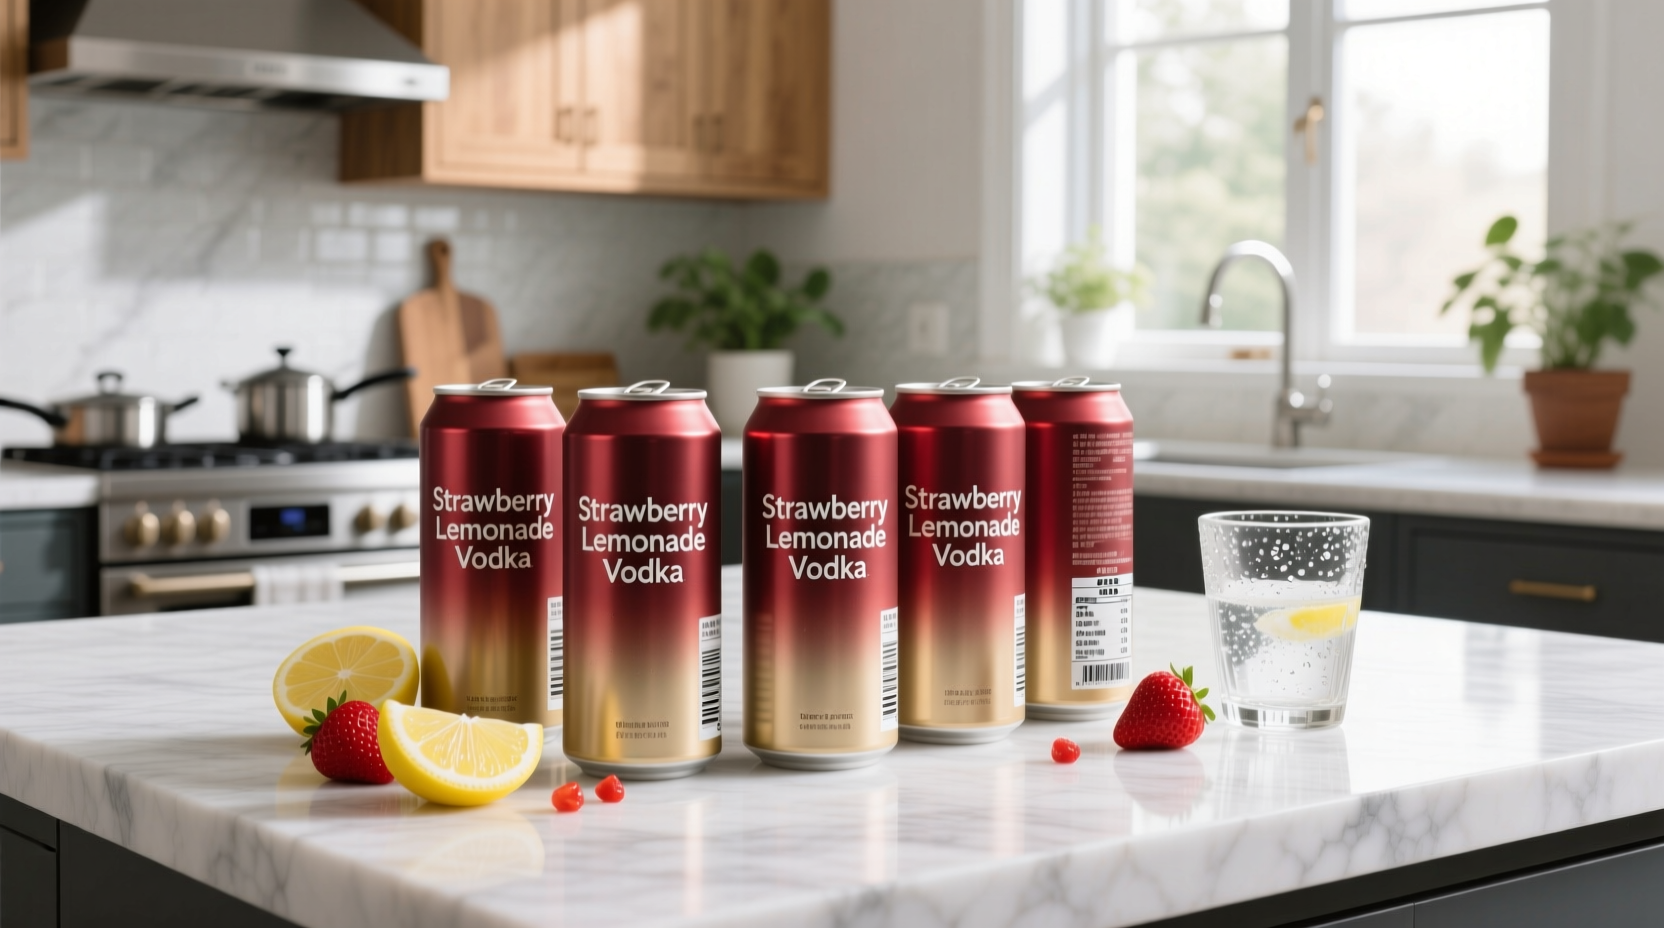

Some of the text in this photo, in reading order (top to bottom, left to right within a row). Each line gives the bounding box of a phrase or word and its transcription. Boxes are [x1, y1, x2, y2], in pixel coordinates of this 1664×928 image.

[433, 486, 554, 517] Strawberry
[762, 494, 888, 525] Strawberry
[905, 484, 1021, 514] Strawberry
[579, 496, 708, 528] Strawberry
[908, 512, 1020, 537] Lemonade
[436, 516, 554, 540] Lemonade
[582, 526, 706, 553] Lemonade
[766, 524, 886, 549] Lemonade
[455, 545, 532, 569] Vodka
[788, 555, 867, 580] Vodka
[932, 543, 1005, 567] Vodka
[602, 558, 684, 584] Vodka
